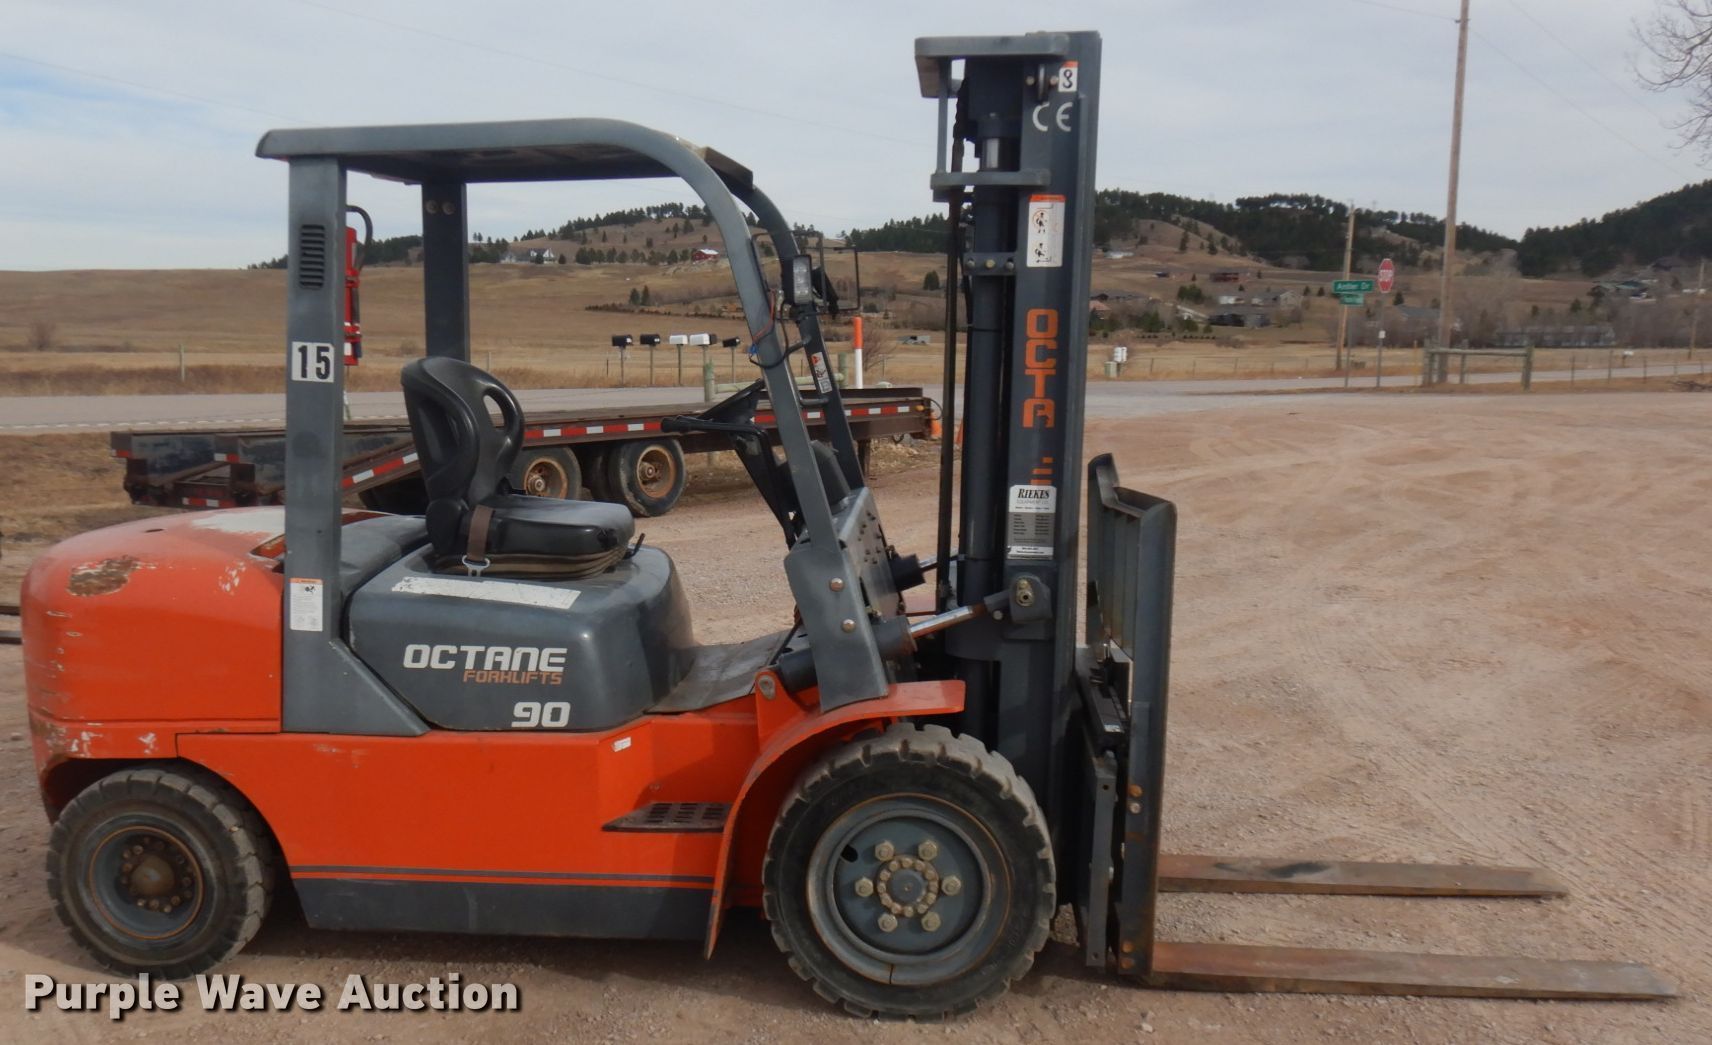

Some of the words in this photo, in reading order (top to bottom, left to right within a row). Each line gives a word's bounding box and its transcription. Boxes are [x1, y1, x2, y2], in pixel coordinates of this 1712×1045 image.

[1032, 101, 1074, 132] CE
[1379, 269, 1393, 281] STOP
[298, 345, 331, 380] 15
[1022, 308, 1059, 486] OCTA
[1017, 488, 1050, 499] RIEKES
[403, 644, 568, 672] OCTANE
[463, 670, 563, 686] FORKLIFTS
[511, 701, 571, 728] 90
